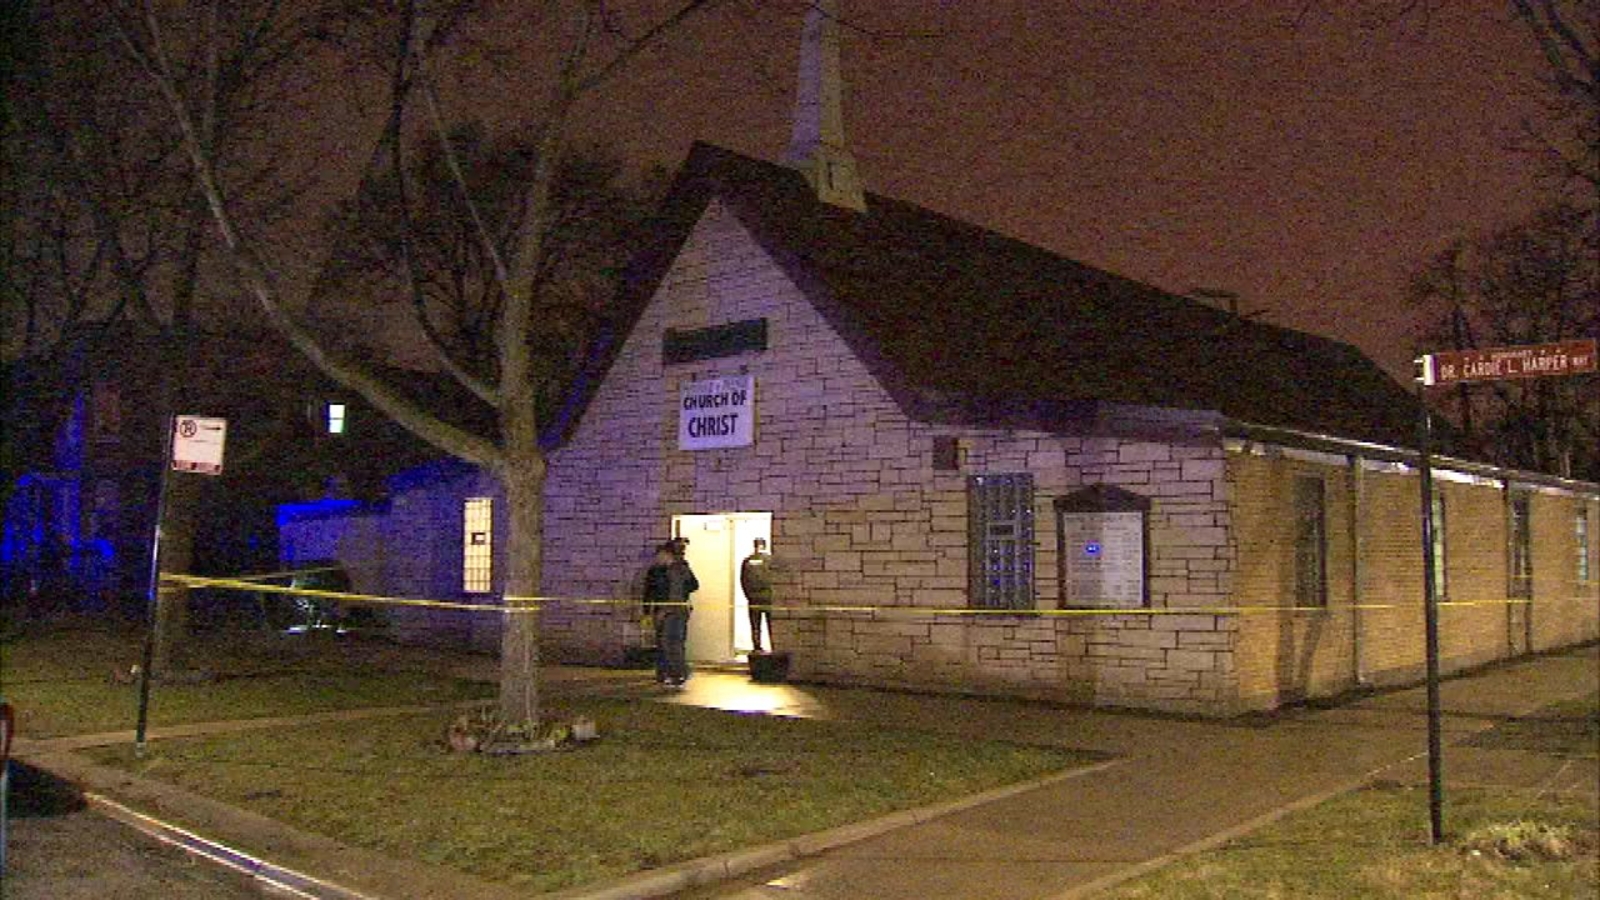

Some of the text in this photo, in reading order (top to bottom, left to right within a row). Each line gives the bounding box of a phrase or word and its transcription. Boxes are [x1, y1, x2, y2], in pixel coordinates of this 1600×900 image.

[1523, 354, 1567, 373] HARPER
[683, 389, 747, 411] CHURCH OF
[688, 414, 739, 438] CHRIST
